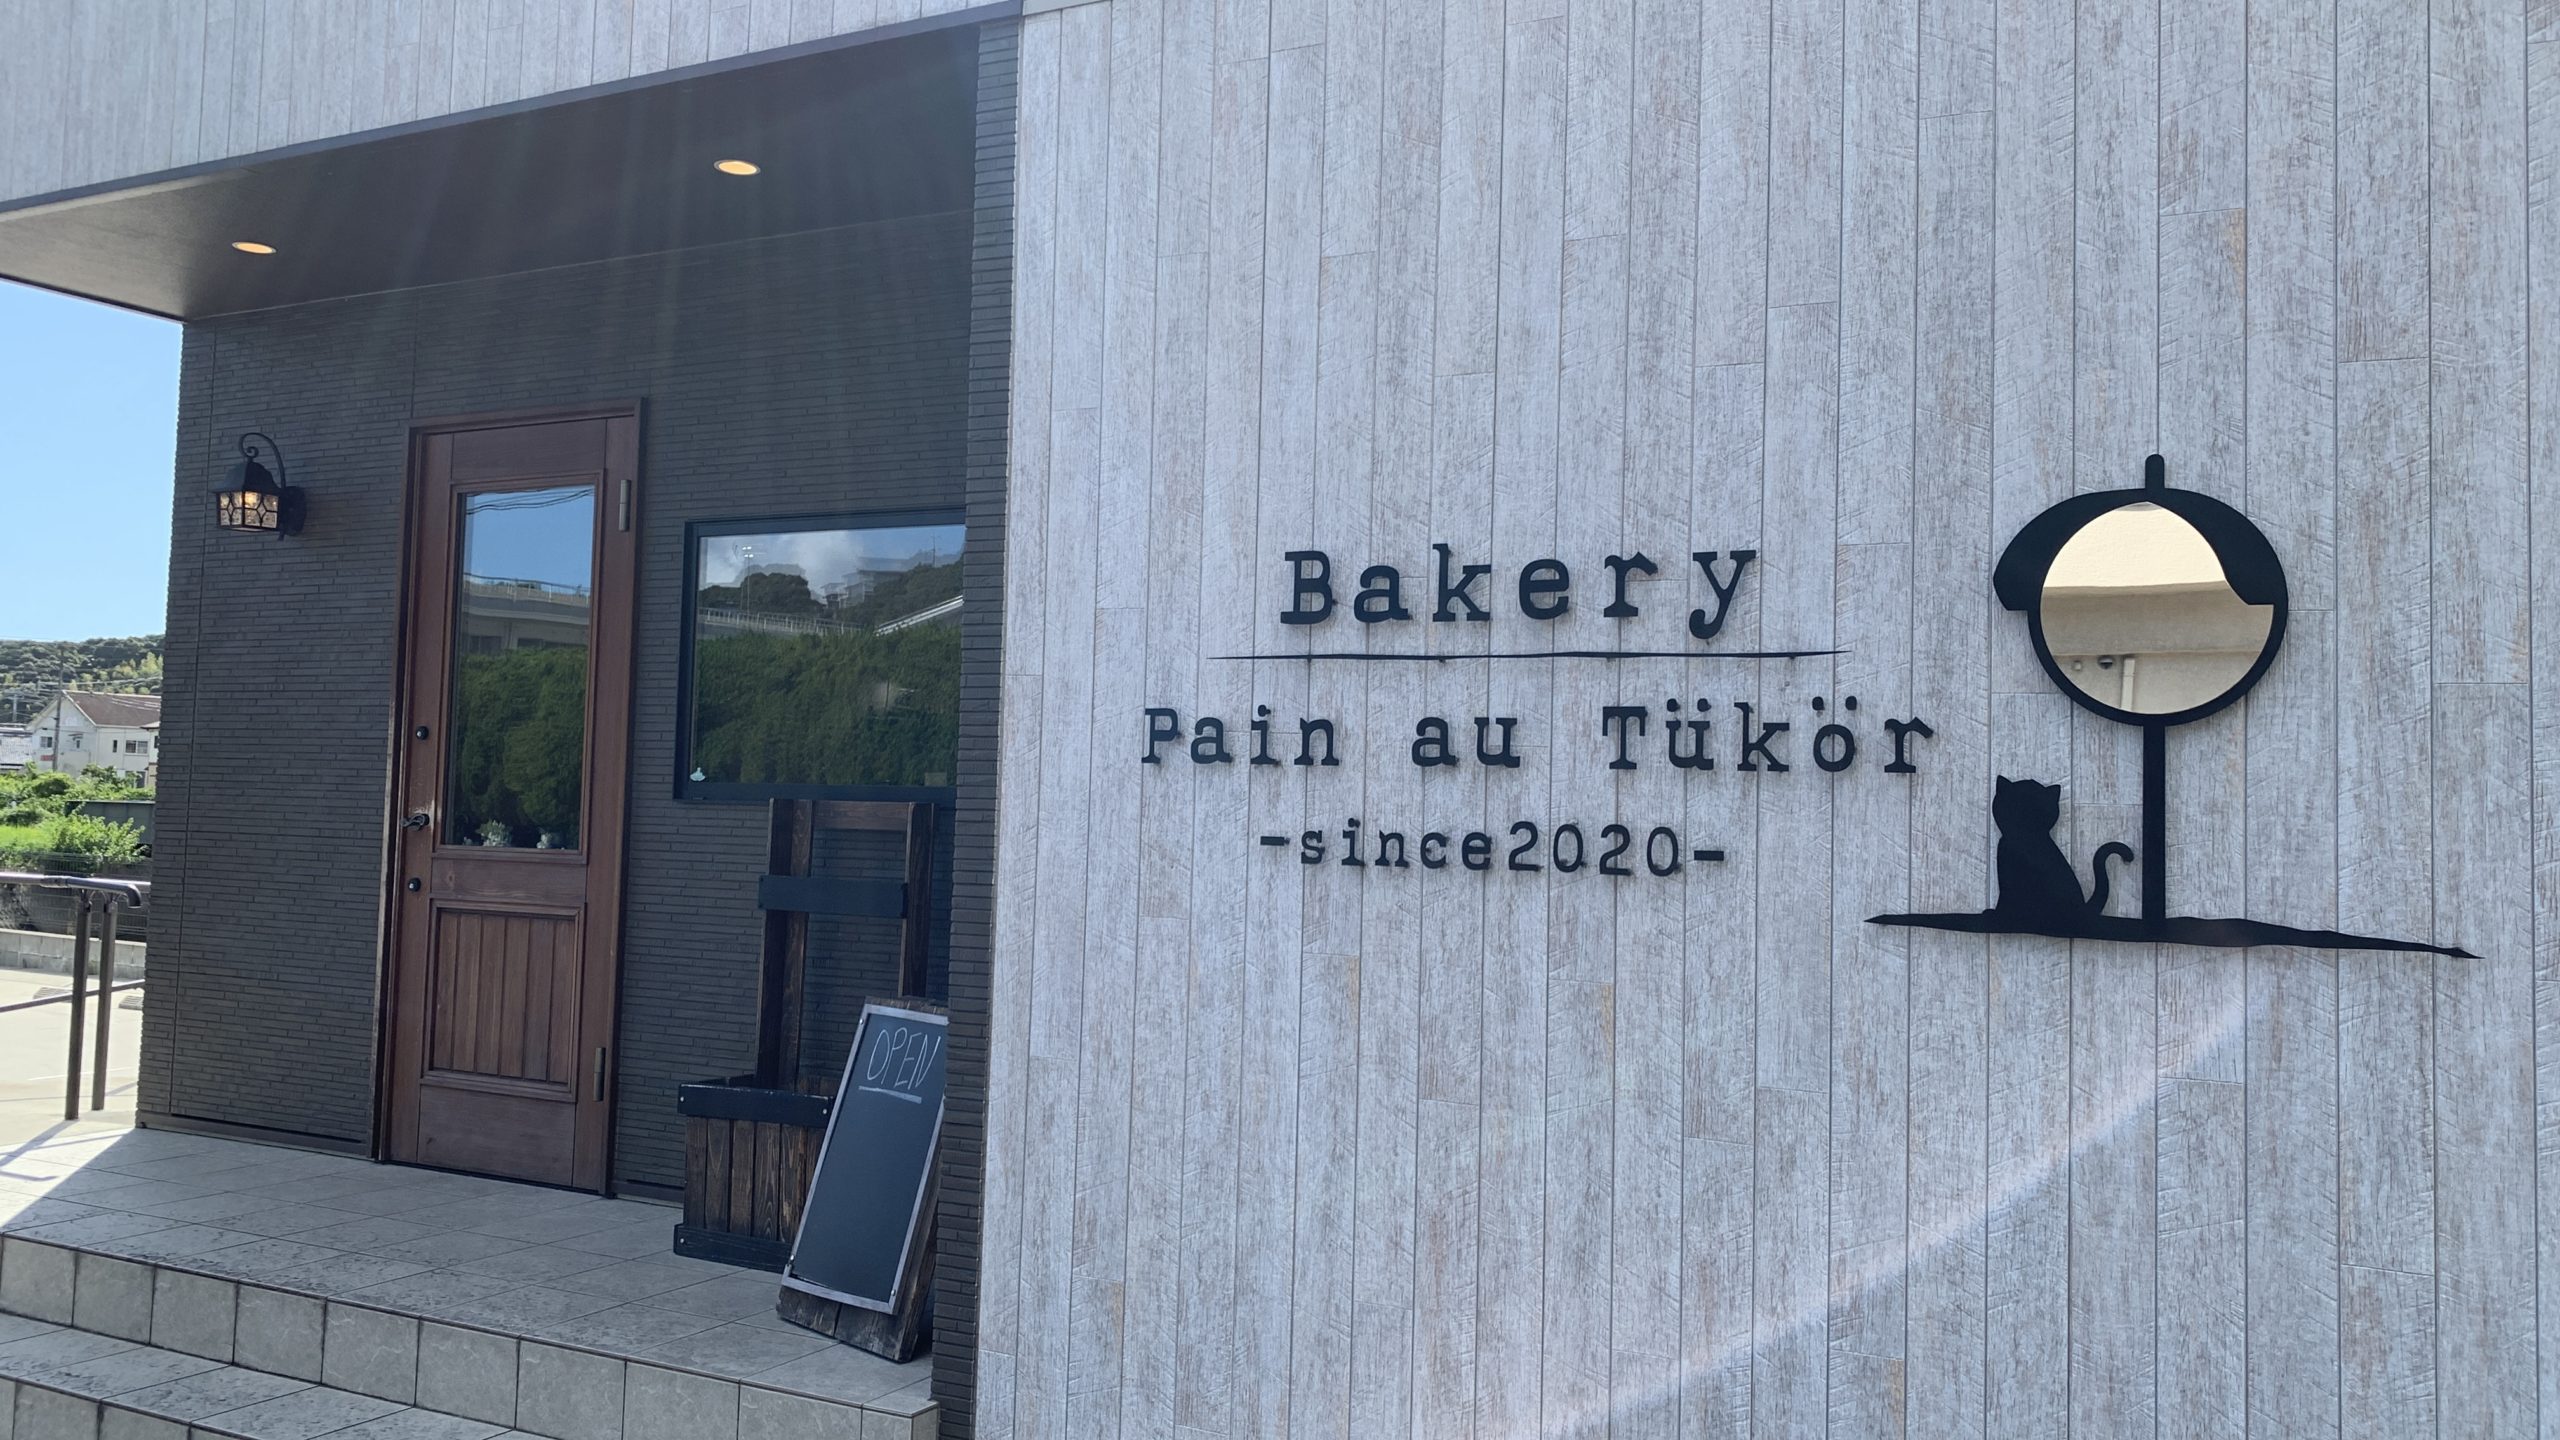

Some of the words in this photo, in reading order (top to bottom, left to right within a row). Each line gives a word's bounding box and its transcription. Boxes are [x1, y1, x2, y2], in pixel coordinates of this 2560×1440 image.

[1280, 543, 1757, 640] Bakery
[1142, 704, 1340, 767] Pain
[1411, 715, 1521, 769] au
[1602, 695, 1934, 774] Tükör
[867, 1028, 941, 1090] OPEN
